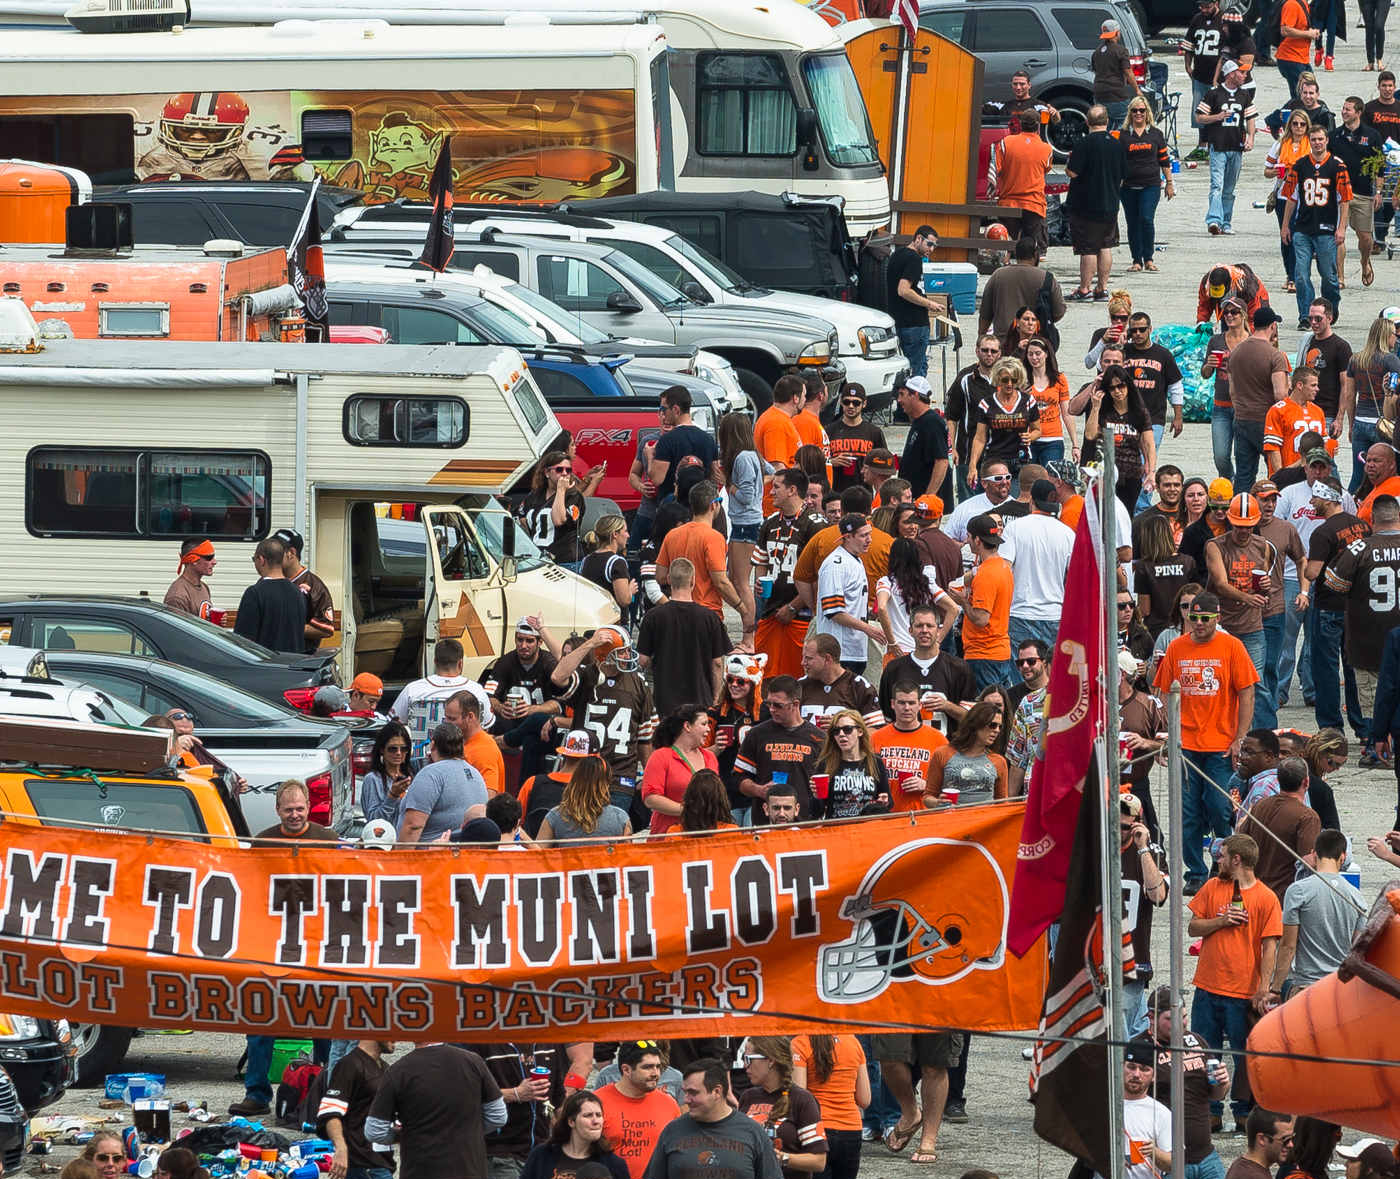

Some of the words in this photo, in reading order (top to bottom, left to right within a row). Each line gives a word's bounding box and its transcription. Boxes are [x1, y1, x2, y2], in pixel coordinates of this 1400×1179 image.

[1194, 29, 1220, 56] 32
[1303, 178, 1332, 206] 85
[573, 429, 632, 443] FX4
[831, 440, 874, 453] BROWNS
[766, 541, 798, 583] 54
[1155, 565, 1184, 577] PINK
[584, 703, 632, 755] 54
[765, 743, 812, 756] CLEVELAND
[880, 747, 930, 762] CLEVELAND
[771, 752, 804, 763] BROWNS
[886, 759, 921, 771] FUCKIN
[834, 775, 876, 792] BROWNS
[144, 864, 242, 960] TO
[269, 874, 423, 969] THE
[450, 863, 657, 970] MUNI
[682, 849, 829, 956] LOT
[1, 950, 123, 1013] LOT
[148, 972, 434, 1031] BROWNS
[457, 957, 764, 1031] BACKERS
[621, 1119, 656, 1129] Drank
[621, 1129, 643, 1139] The
[620, 1139, 650, 1149] Muni
[675, 1137, 746, 1152] CLEVELAND
[620, 1148, 642, 1158] Lot!
